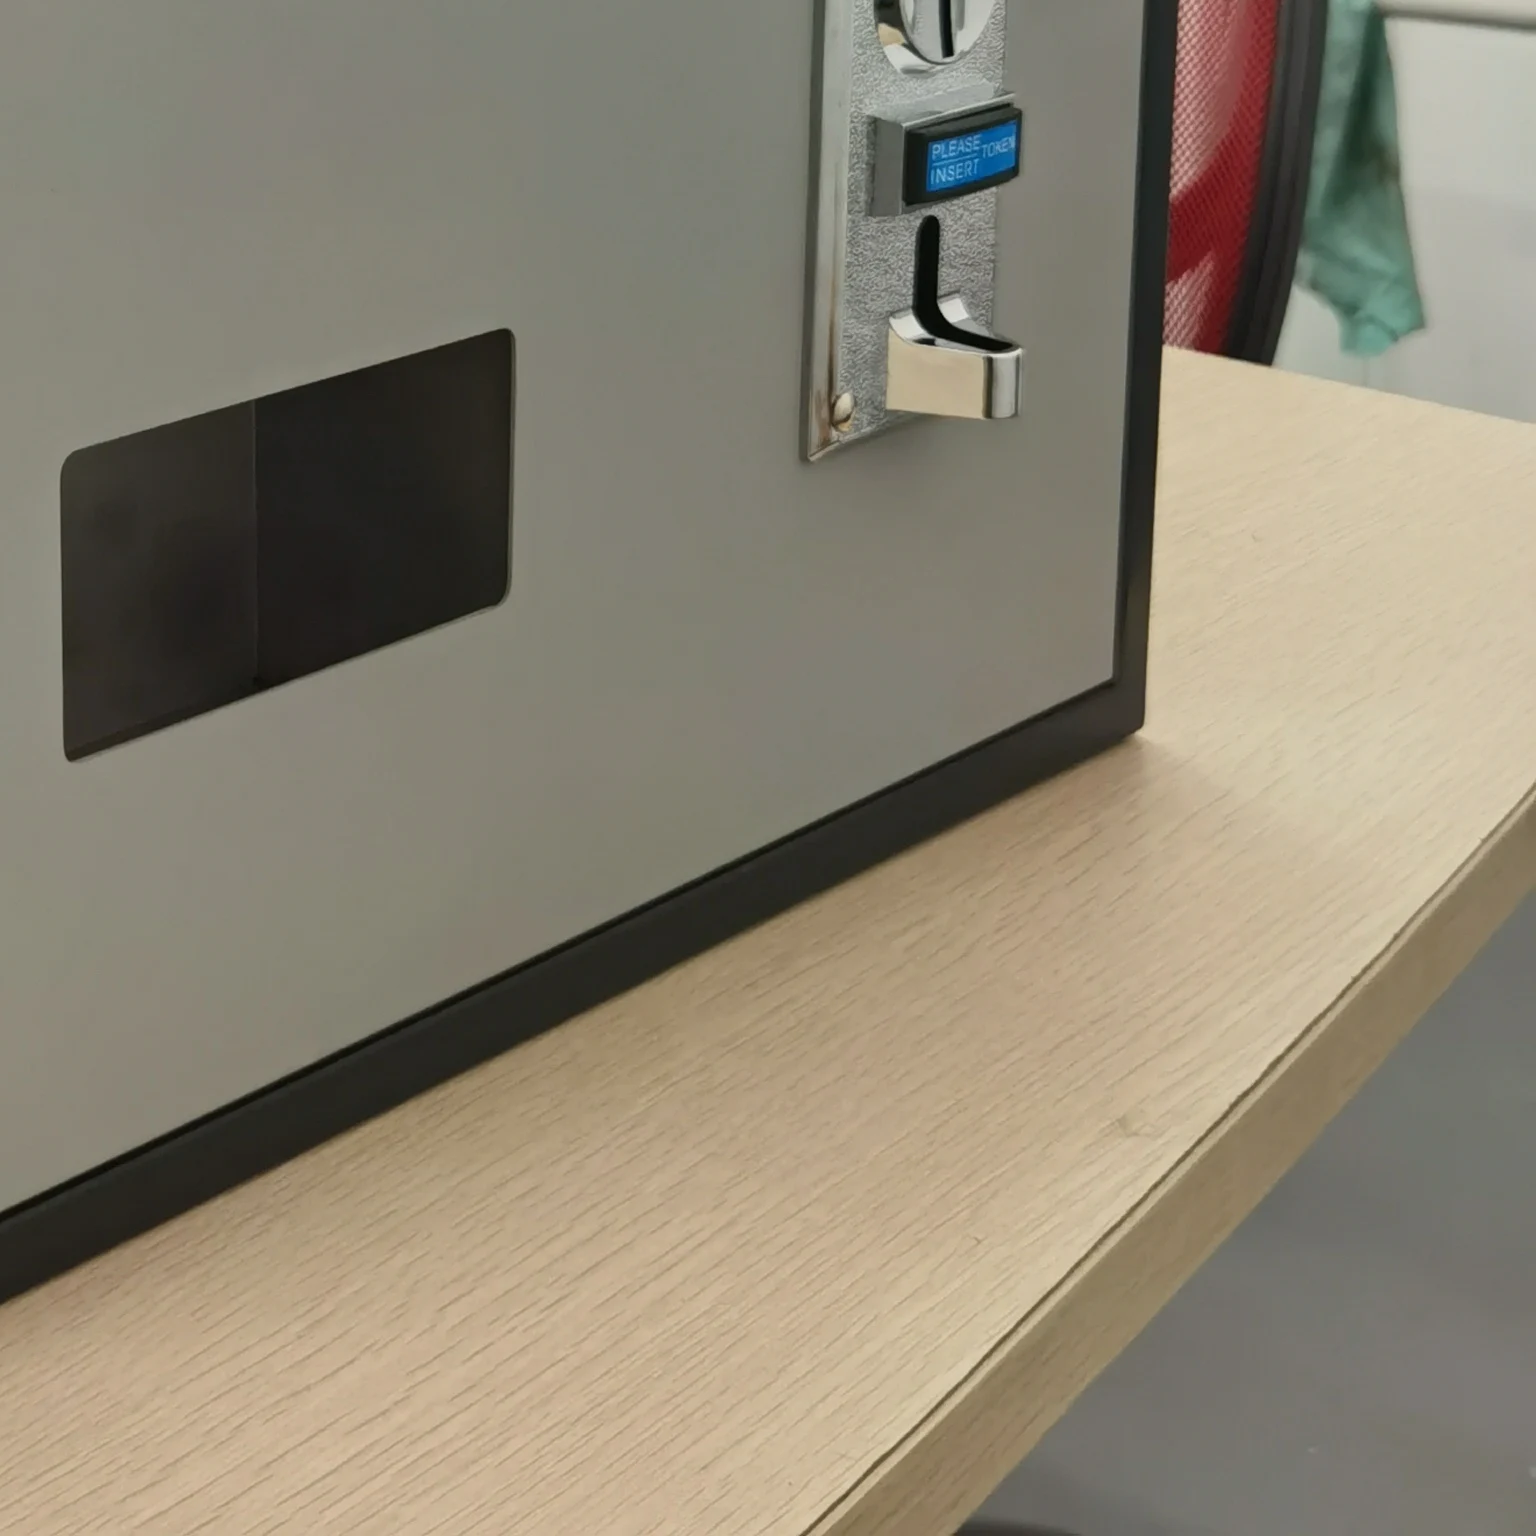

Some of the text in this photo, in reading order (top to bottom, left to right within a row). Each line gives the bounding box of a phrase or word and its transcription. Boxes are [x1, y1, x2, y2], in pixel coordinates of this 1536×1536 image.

[932, 134, 981, 160] PLEASE
[982, 135, 1015, 158] TOKEN
[931, 158, 980, 184] INSERT
